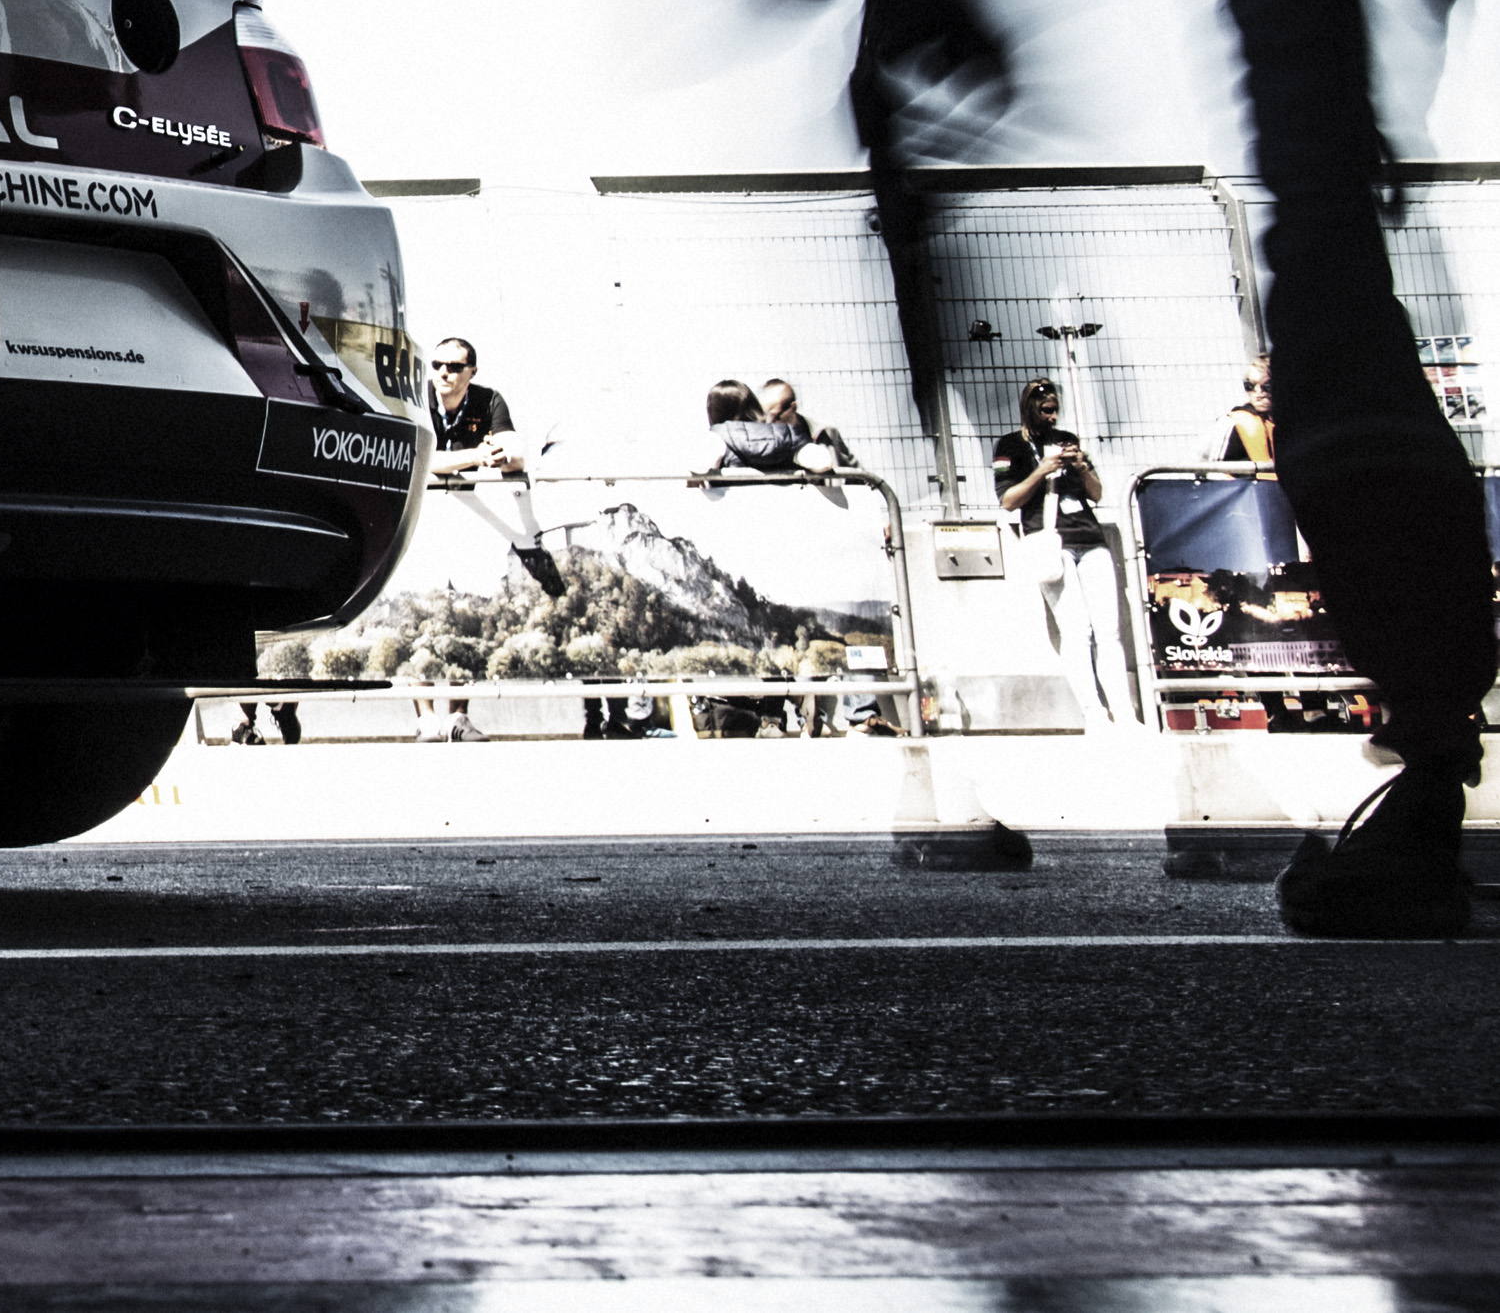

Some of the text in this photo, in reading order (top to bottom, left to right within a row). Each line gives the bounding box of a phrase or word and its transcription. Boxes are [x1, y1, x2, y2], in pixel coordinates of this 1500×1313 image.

[4, 339, 146, 365] kwsuspensions.de
[312, 426, 411, 473] YOKOHAMA
[1164, 645, 1234, 663] Slovakia
